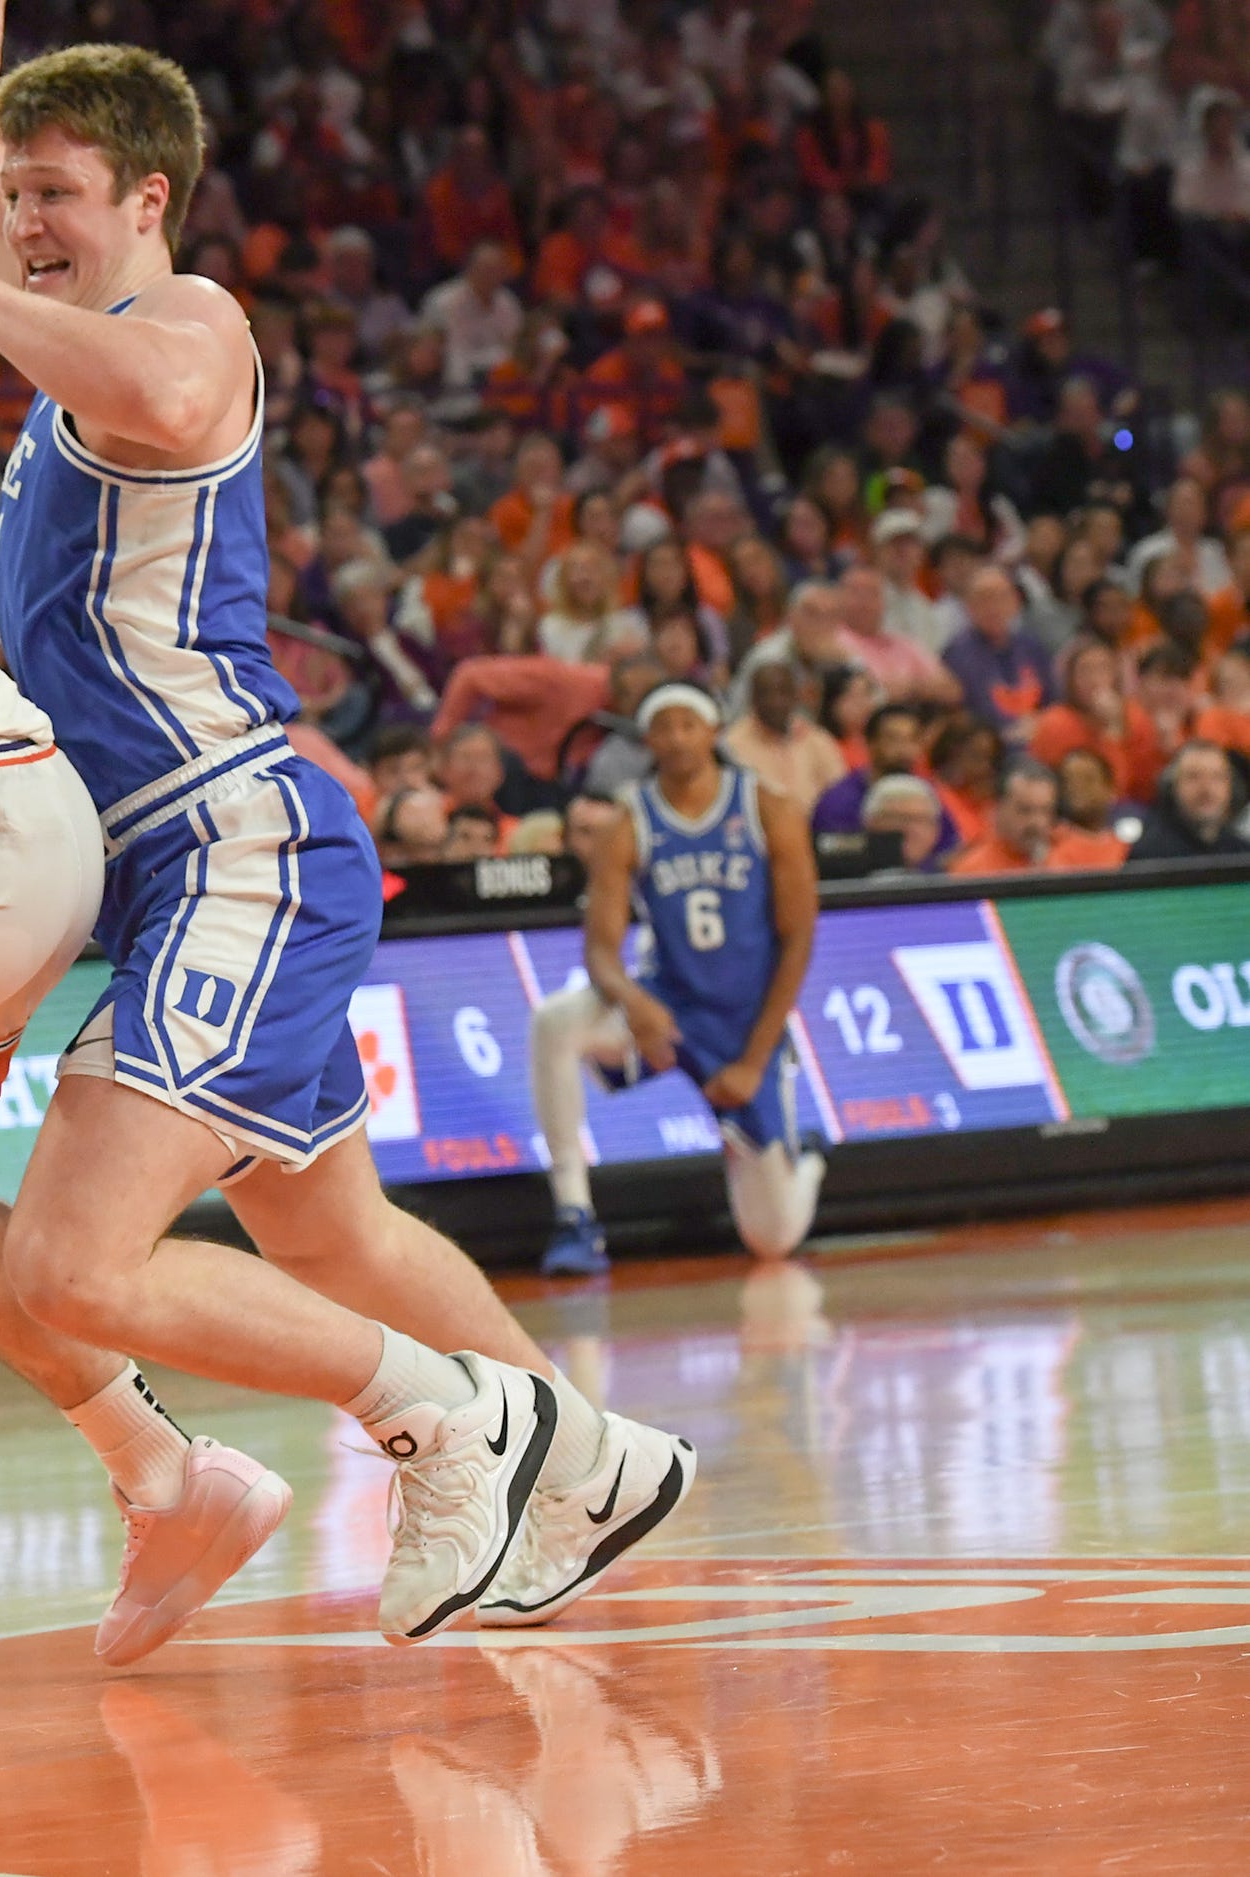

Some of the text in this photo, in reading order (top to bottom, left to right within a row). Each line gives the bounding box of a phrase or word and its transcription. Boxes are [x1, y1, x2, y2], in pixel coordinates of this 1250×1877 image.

[653, 851, 753, 897] DUKE
[686, 889, 726, 953] 6
[822, 985, 903, 1055] 12
[1171, 961, 1250, 1030] OL
[454, 1006, 503, 1077] 6
